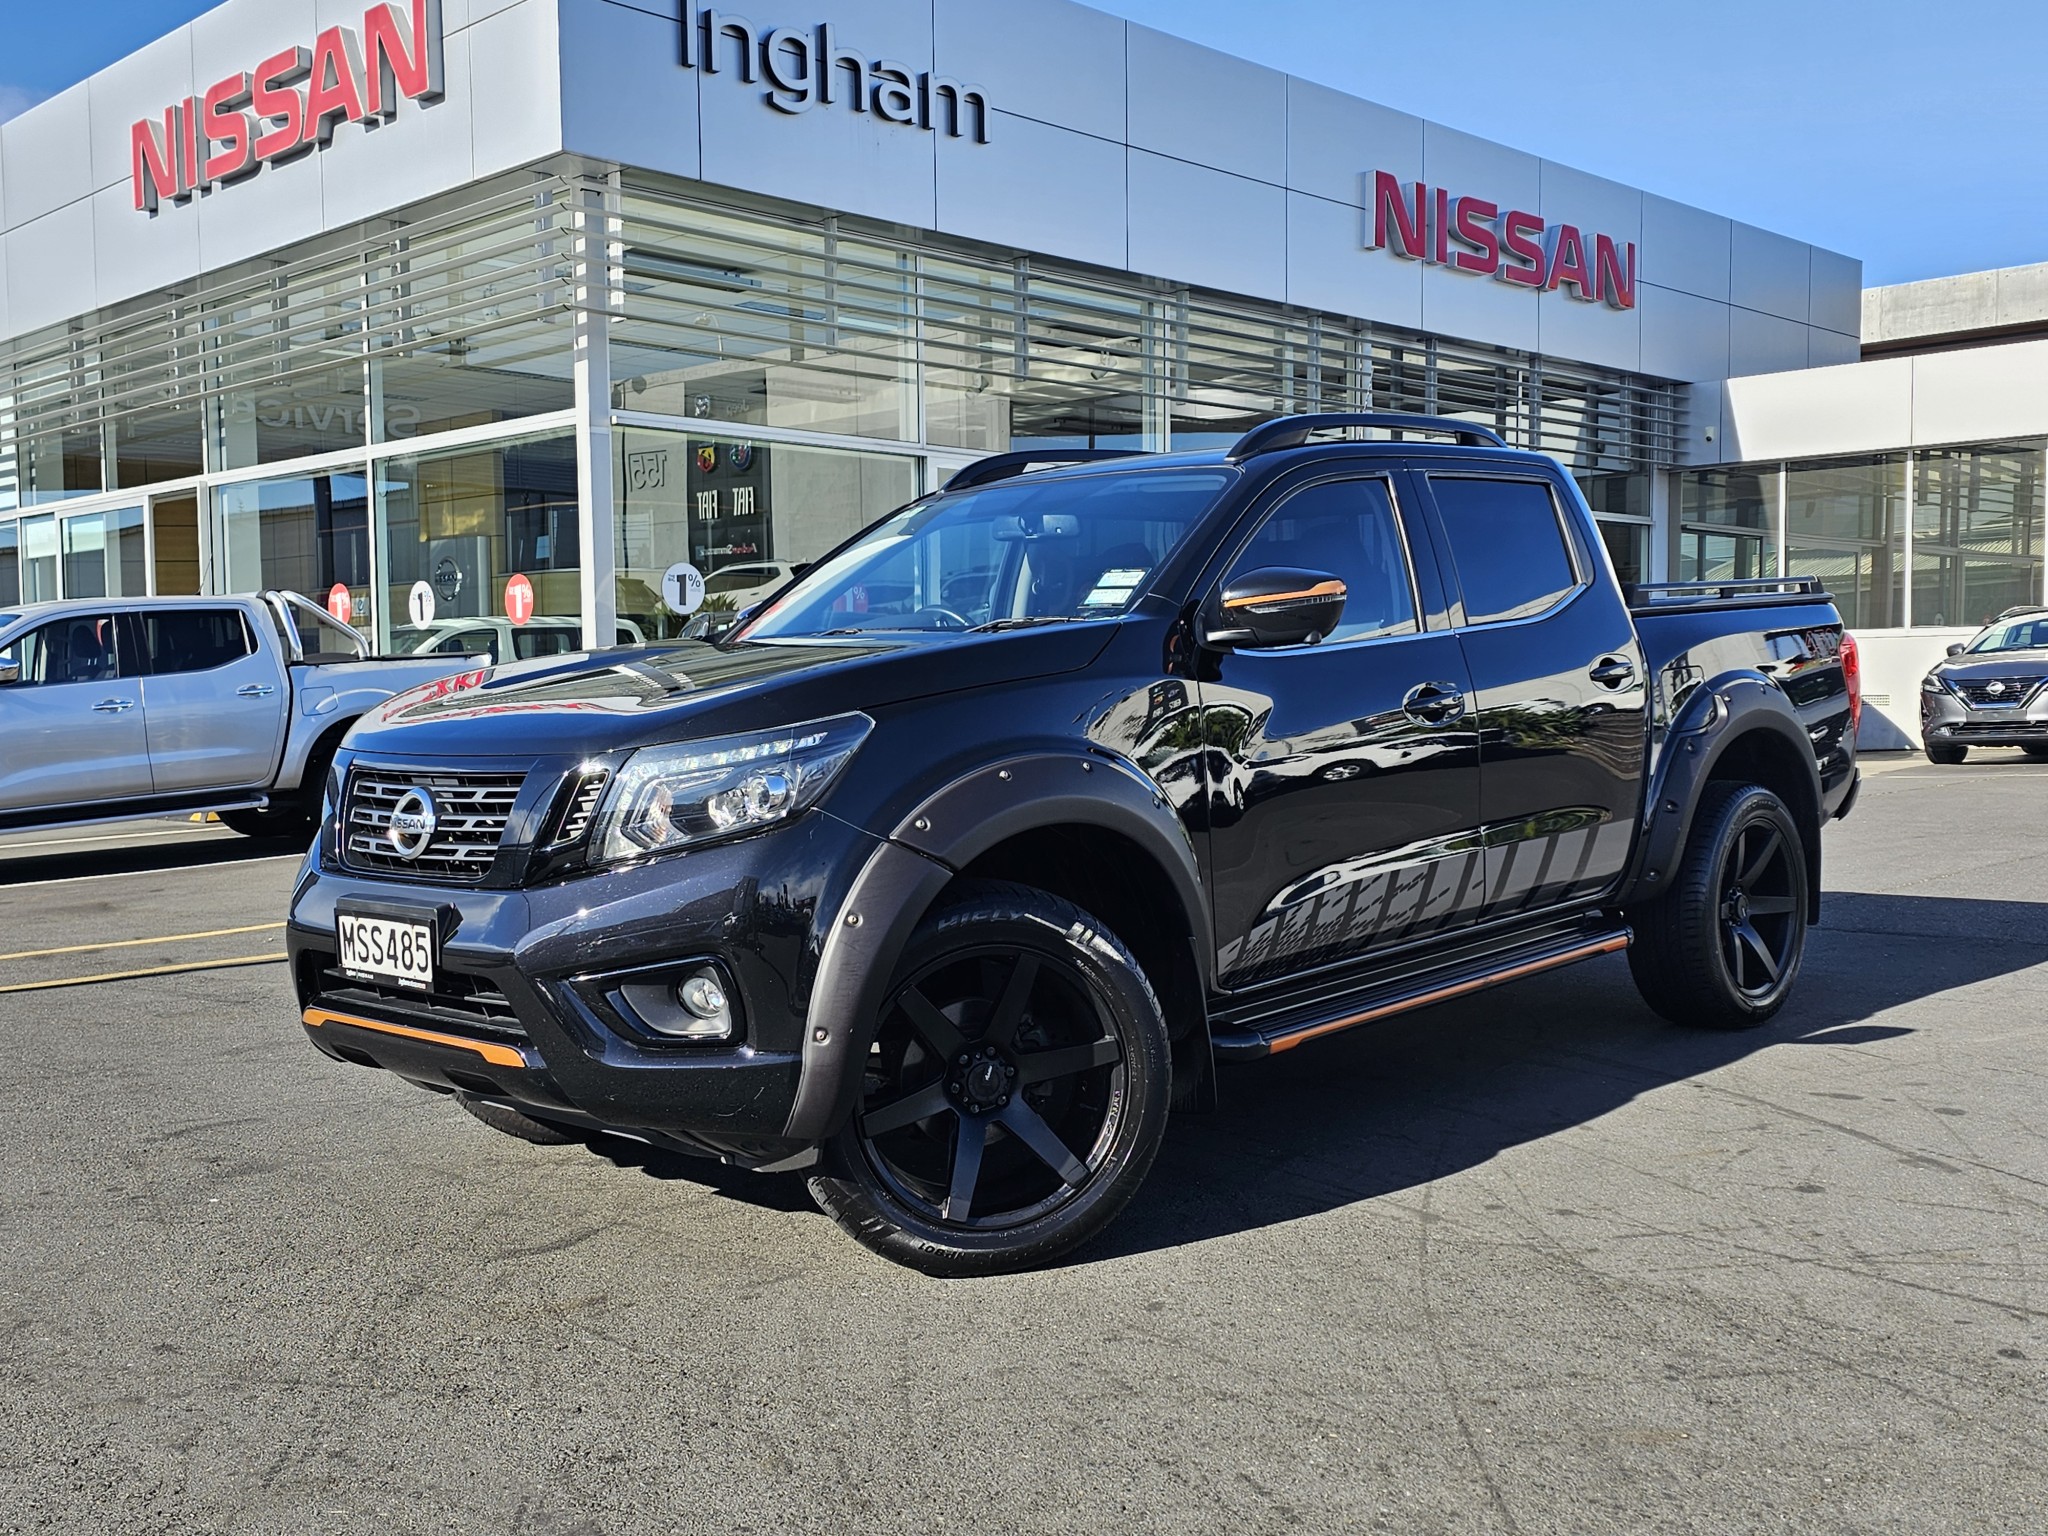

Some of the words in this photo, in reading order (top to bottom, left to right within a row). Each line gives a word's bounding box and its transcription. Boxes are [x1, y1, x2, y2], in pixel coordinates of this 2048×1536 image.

[131, 0, 443, 215] NISSAN
[680, 0, 992, 144] Ingham
[1364, 169, 1635, 309] NISSAN
[342, 921, 429, 974] MSS485
